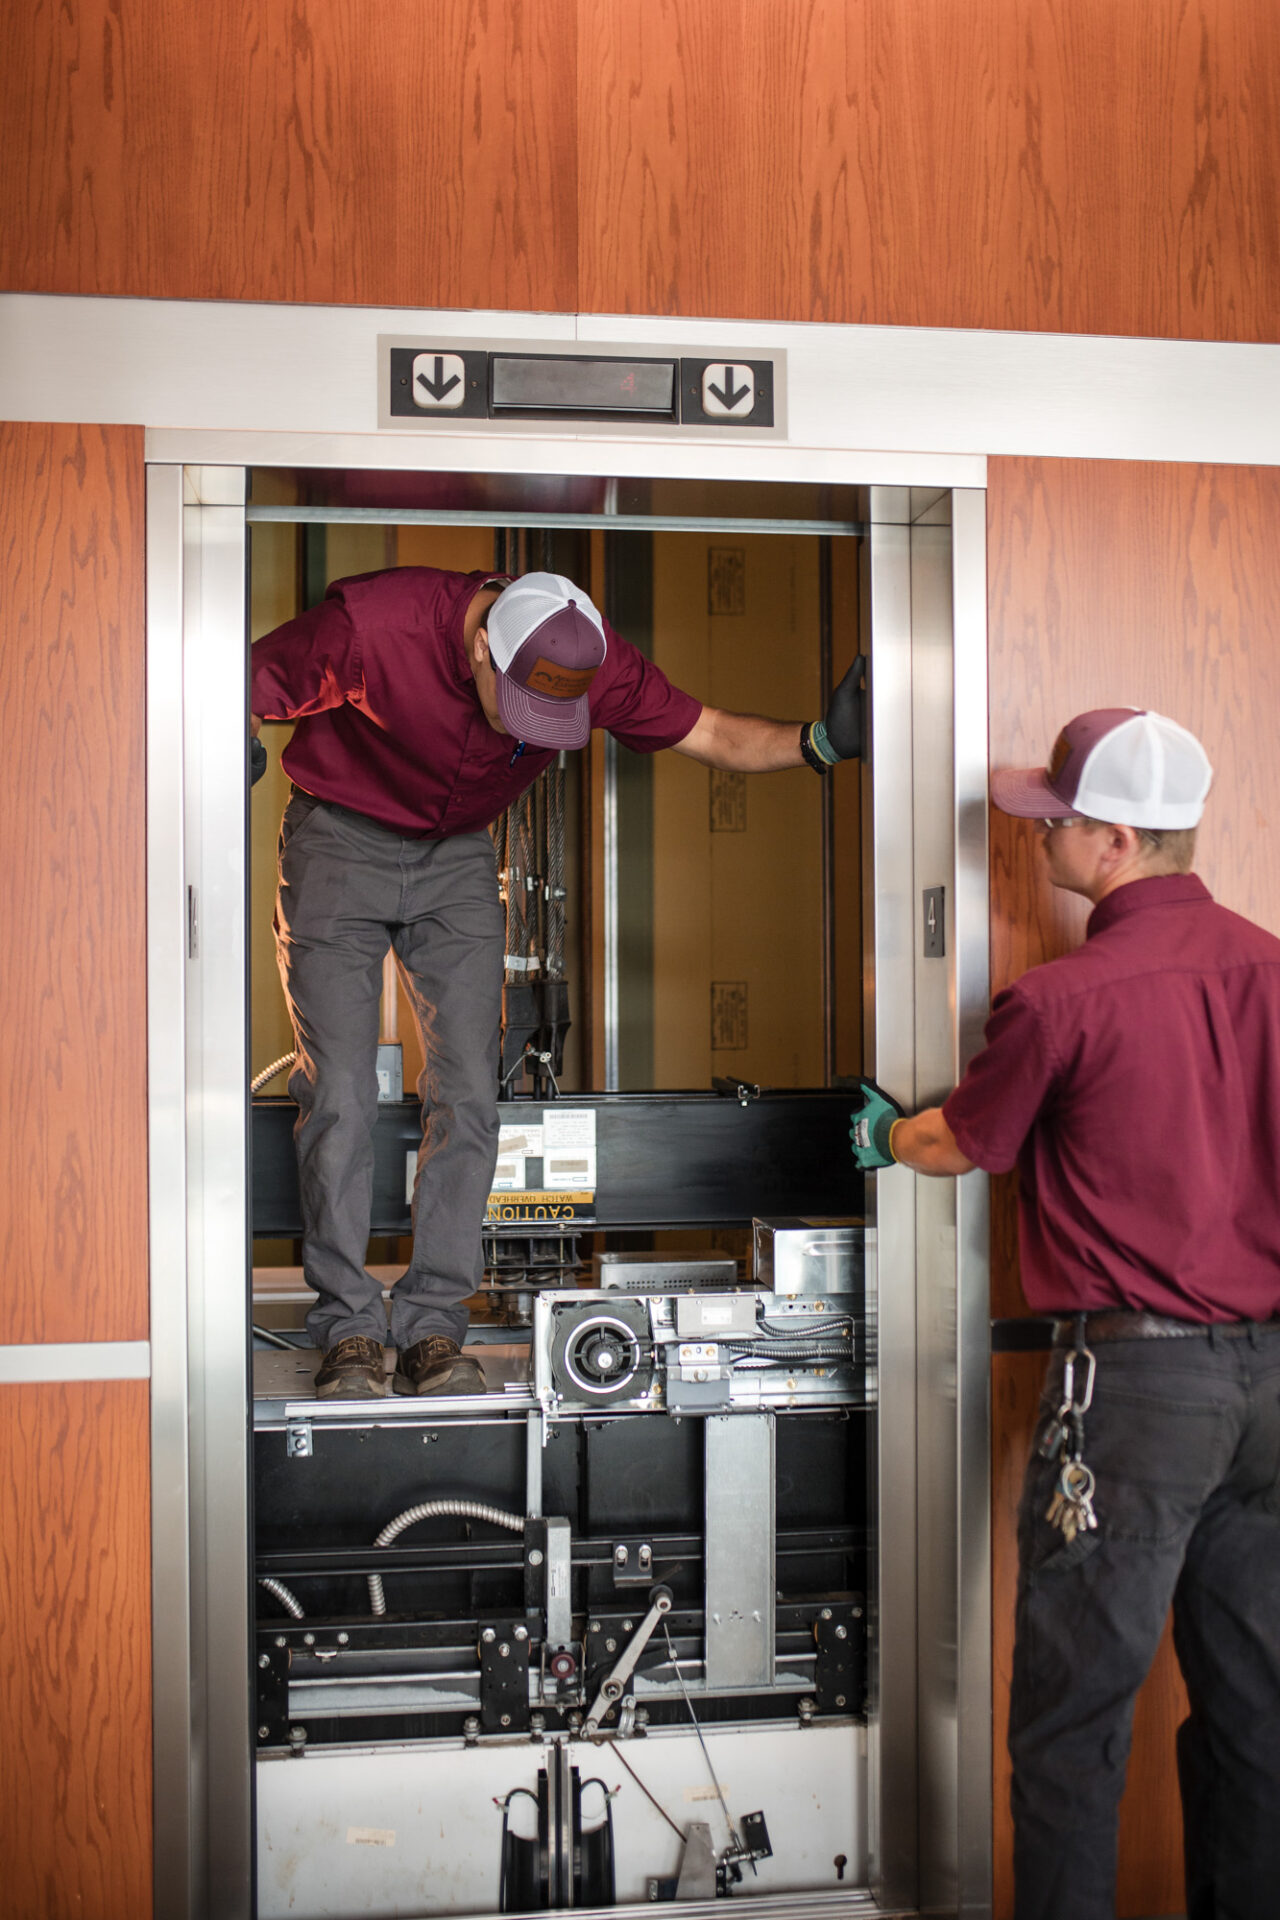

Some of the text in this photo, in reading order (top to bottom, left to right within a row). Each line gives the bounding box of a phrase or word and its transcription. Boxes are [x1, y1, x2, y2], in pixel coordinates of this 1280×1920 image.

[928, 896, 936, 934] 4
[489, 1194, 574, 1204] WATCH OVERHEAD
[488, 1205, 575, 1221] CAUTION
